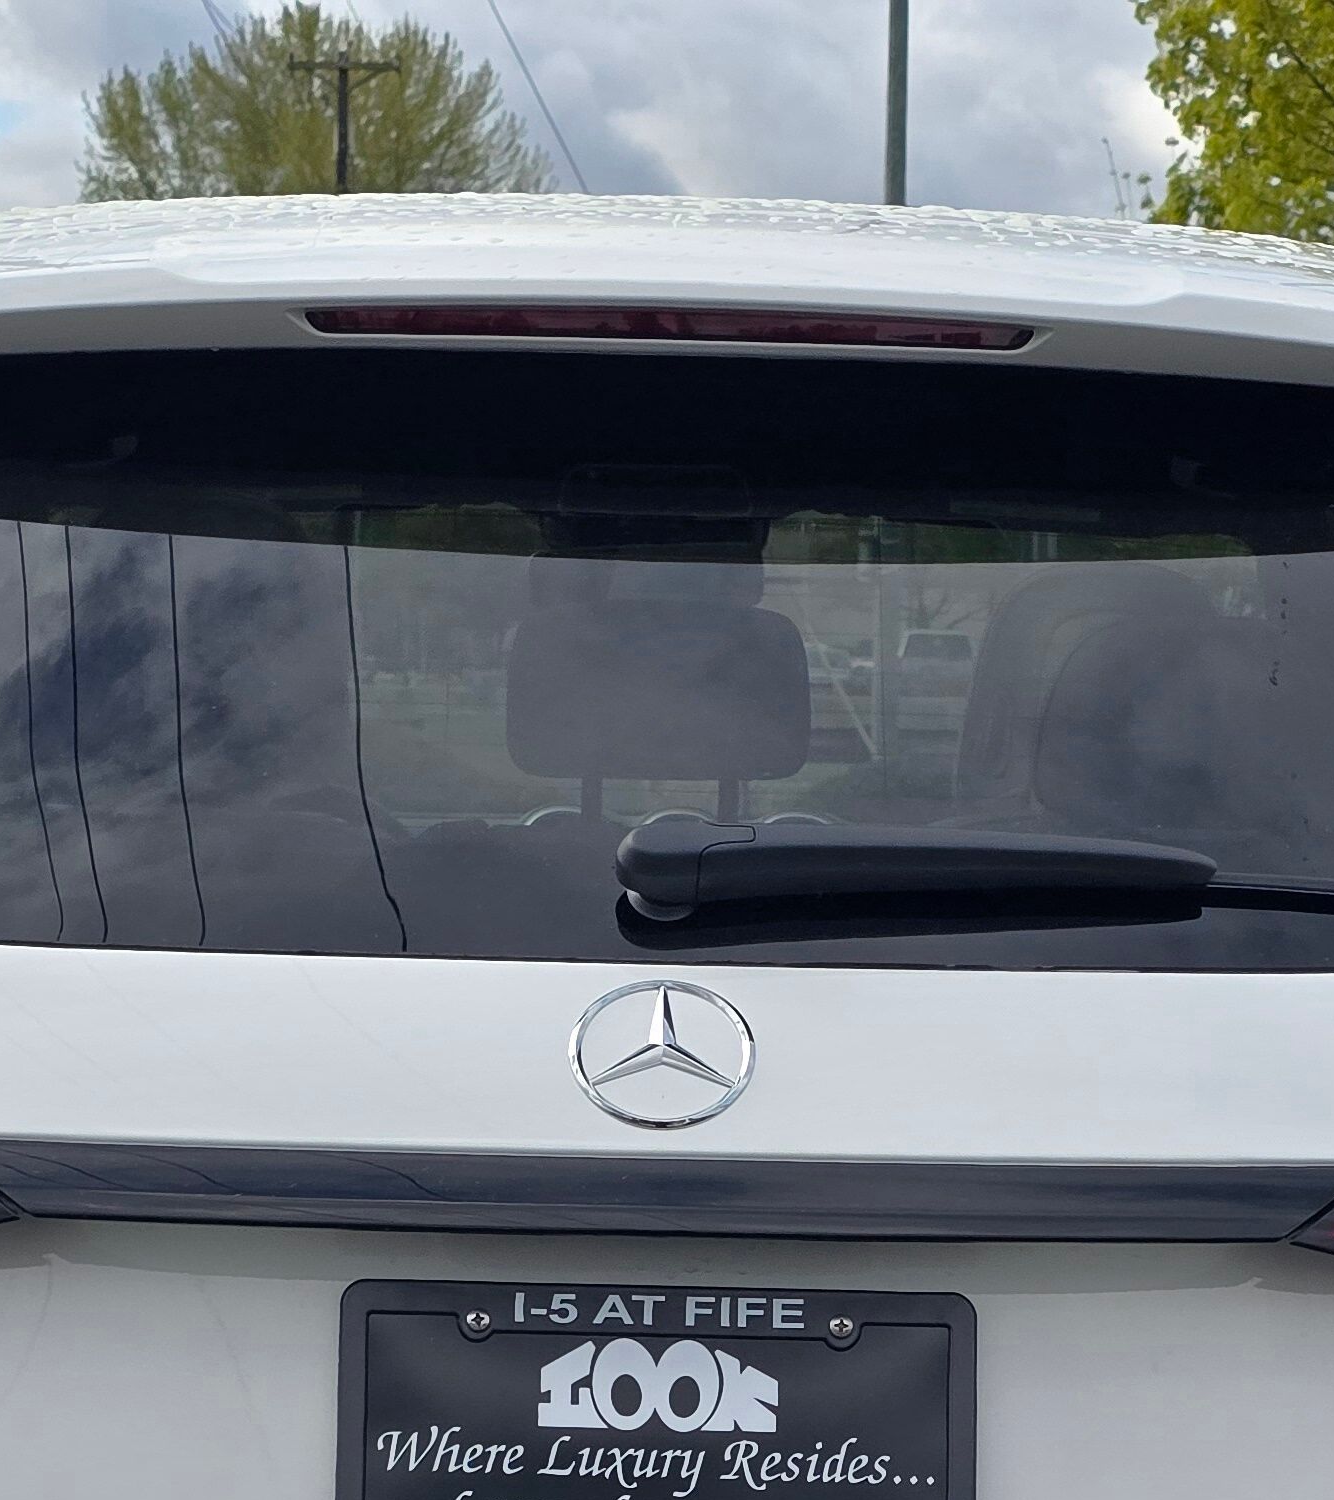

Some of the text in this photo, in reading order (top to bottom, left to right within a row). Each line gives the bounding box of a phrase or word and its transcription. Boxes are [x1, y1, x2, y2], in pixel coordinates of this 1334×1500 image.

[514, 1292, 805, 1329] I-5 AT FIFE
[377, 1425, 935, 1498] Where Luxury Resides...
